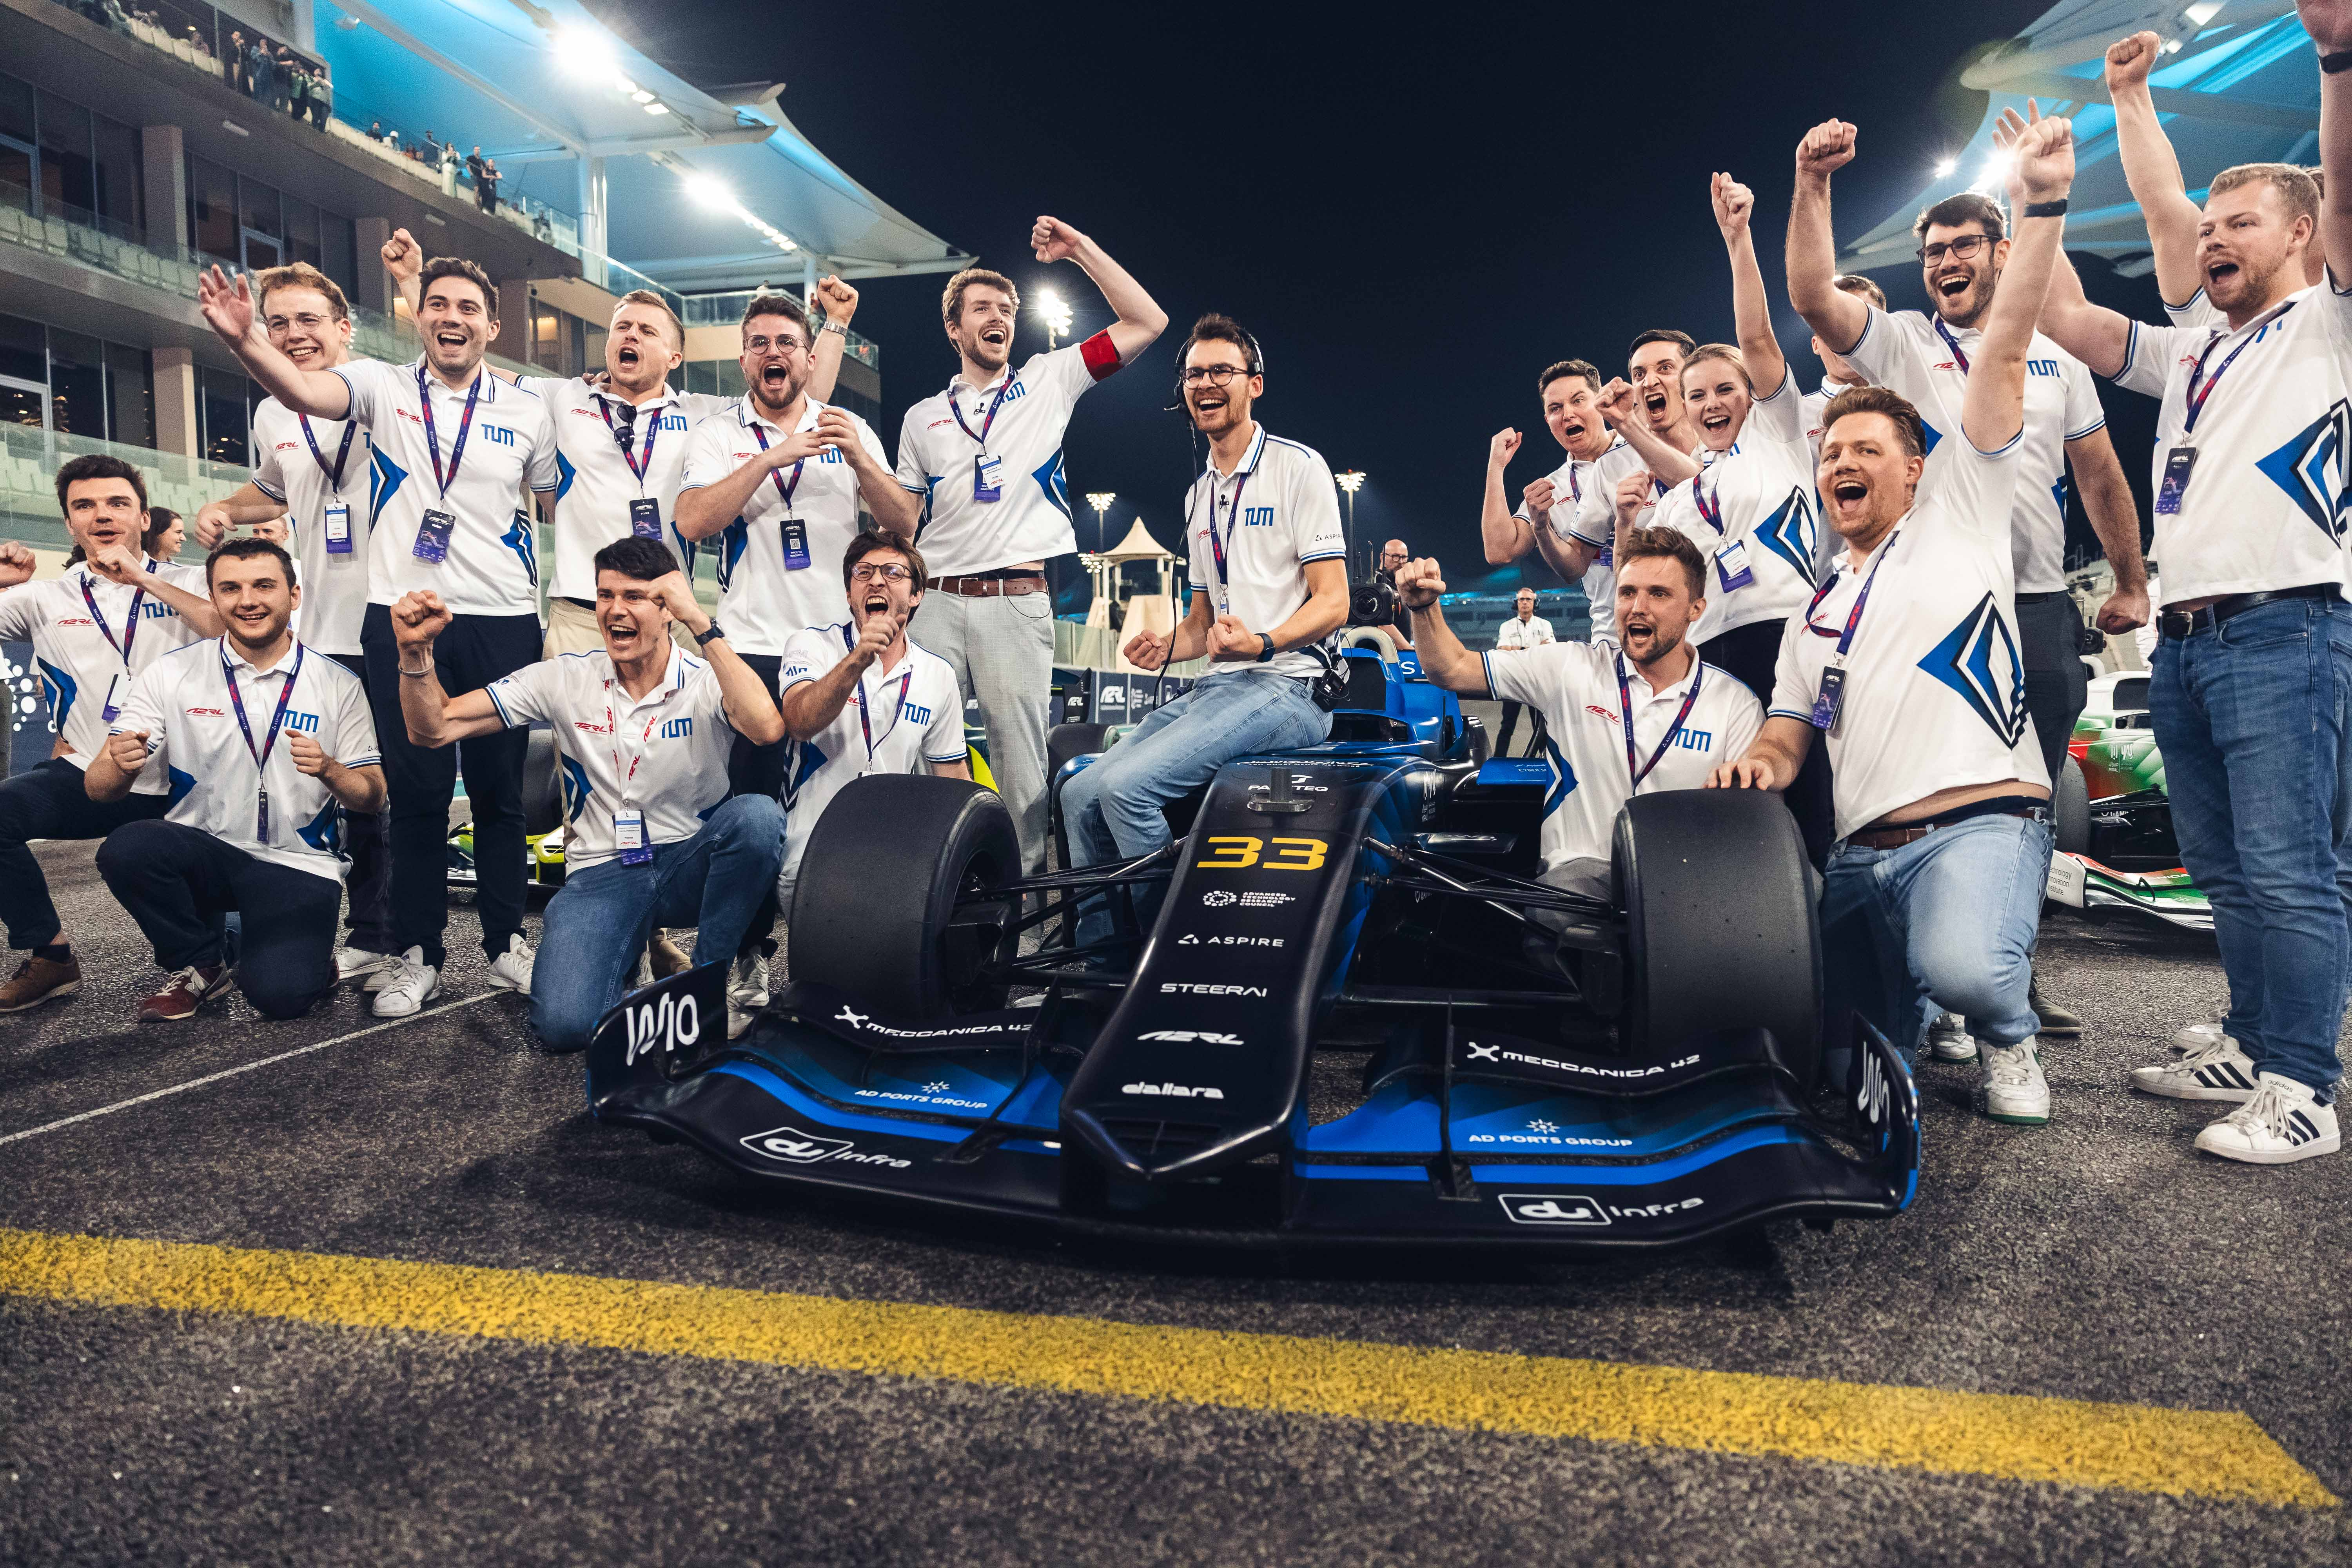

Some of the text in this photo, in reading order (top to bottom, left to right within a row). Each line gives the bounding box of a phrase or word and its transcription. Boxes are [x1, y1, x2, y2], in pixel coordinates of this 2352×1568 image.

[481, 424, 514, 446] TUM
[1245, 507, 1274, 526] TUM
[905, 702, 931, 726] TUM
[1585, 705, 1620, 722] A2RL
[662, 718, 692, 738] TUM
[1666, 729, 1675, 743] ASPIRE
[1675, 728, 1711, 752] TUM
[1197, 837, 1328, 871] 33
[1207, 936, 1285, 947] ASPIRE
[1160, 983, 1268, 997] STEERAI
[866, 1022, 1004, 1037] MECCANICA
[1137, 1031, 1244, 1045] A2RL
[1503, 1051, 1700, 1077] MECCANICA 42
[1122, 1082, 1224, 1099] dallara
[2267, 1079, 2293, 1093] adidas
[879, 1092, 928, 1102] PORTS
[931, 1096, 988, 1109] GROUP
[1499, 1135, 1561, 1144] PORTS
[1565, 1138, 1632, 1146] GROUP
[764, 1138, 911, 1168] du infra
[1518, 1198, 1704, 1218] du infra
